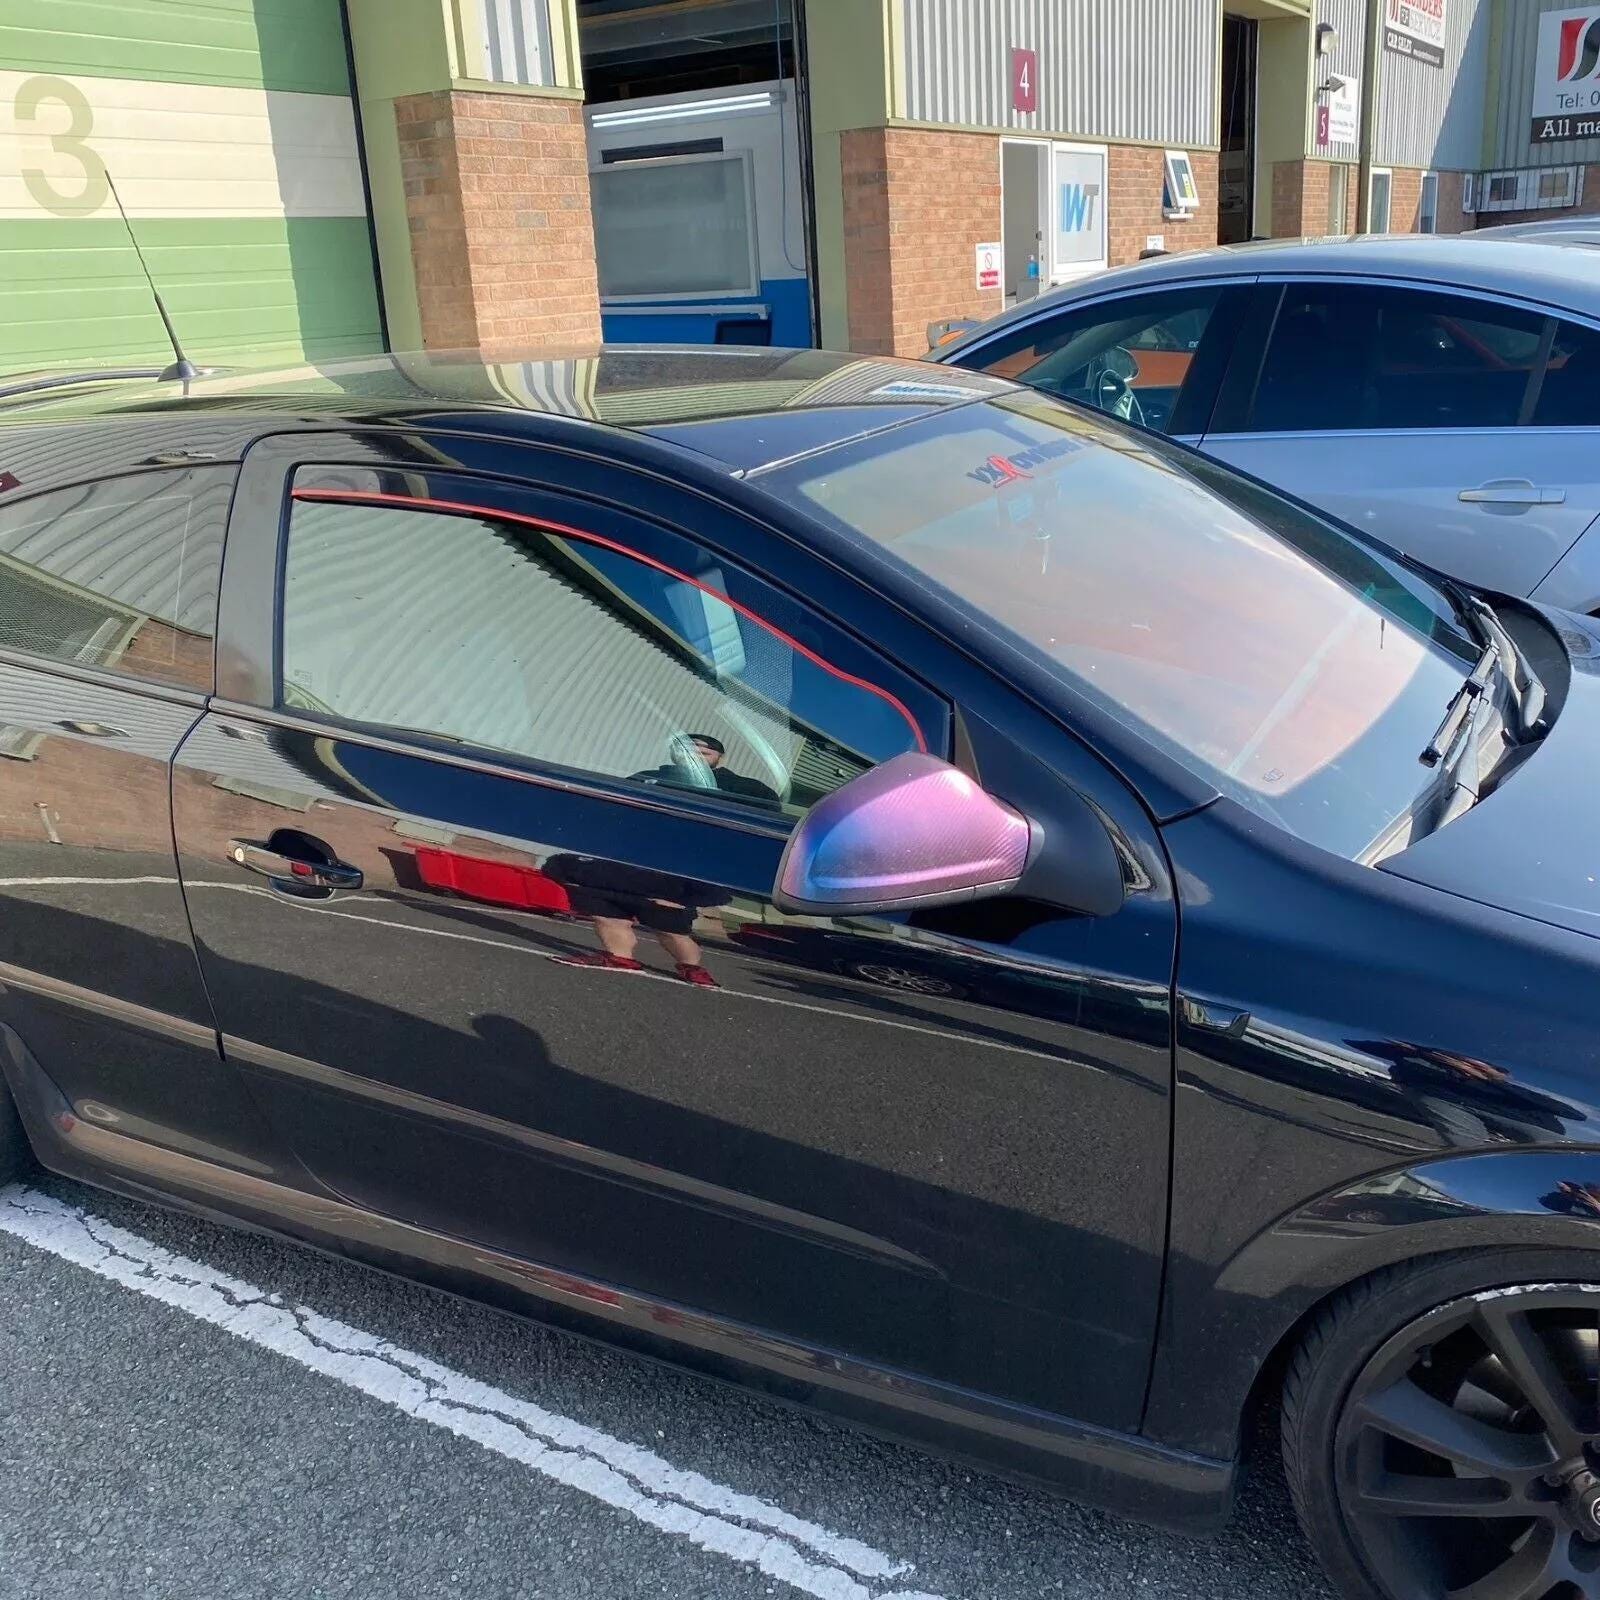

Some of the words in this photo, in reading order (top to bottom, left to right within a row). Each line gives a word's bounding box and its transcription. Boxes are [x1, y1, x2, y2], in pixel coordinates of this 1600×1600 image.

[1019, 60, 1030, 98] 4
[1556, 92, 1584, 109] Tel:
[1320, 112, 1327, 138] 5
[1539, 118, 1570, 138] All
[14, 75, 109, 217] 3
[1060, 183, 1100, 232] WT
